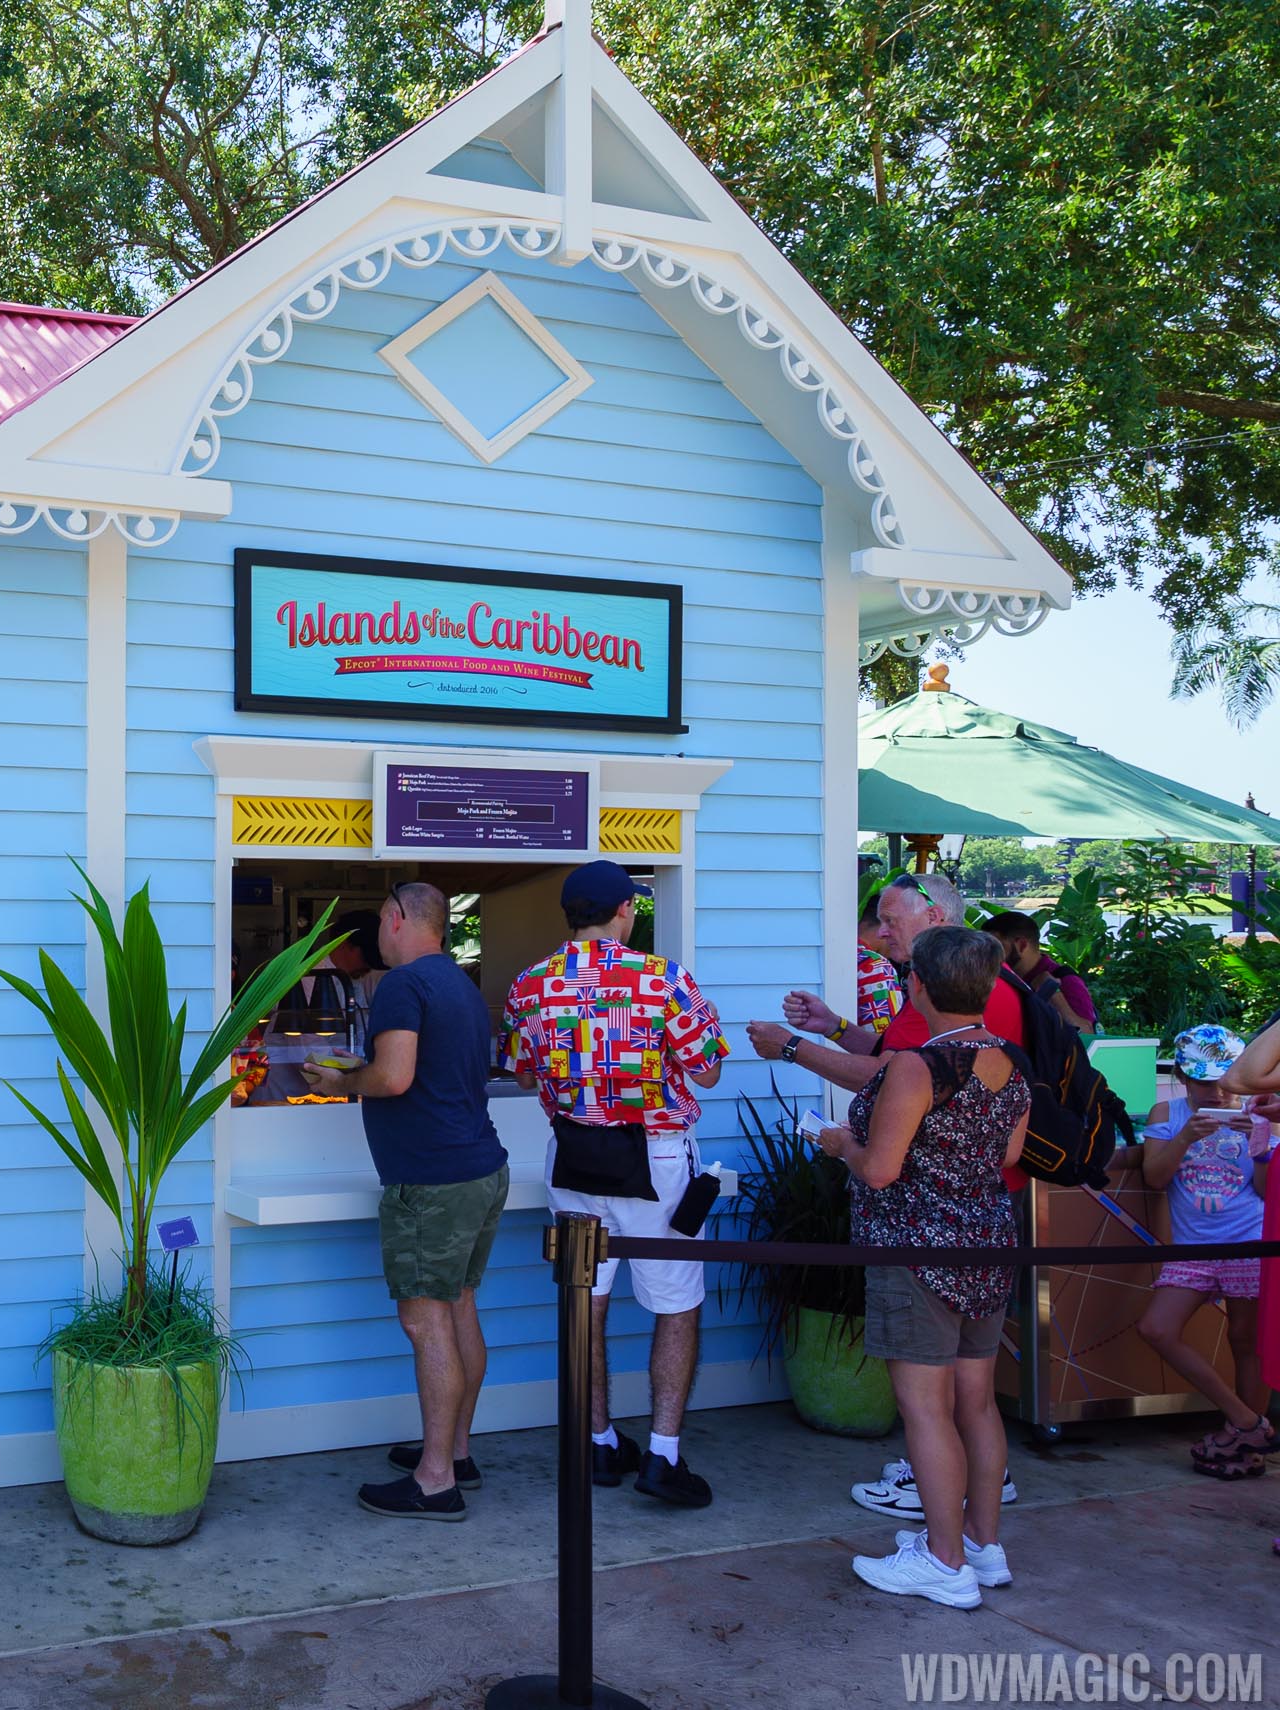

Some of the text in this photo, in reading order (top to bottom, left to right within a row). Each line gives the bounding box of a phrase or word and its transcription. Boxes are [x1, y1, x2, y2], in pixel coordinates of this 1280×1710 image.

[276, 600, 645, 672] Islands of the Caribbean
[437, 682, 478, 694] Introduced
